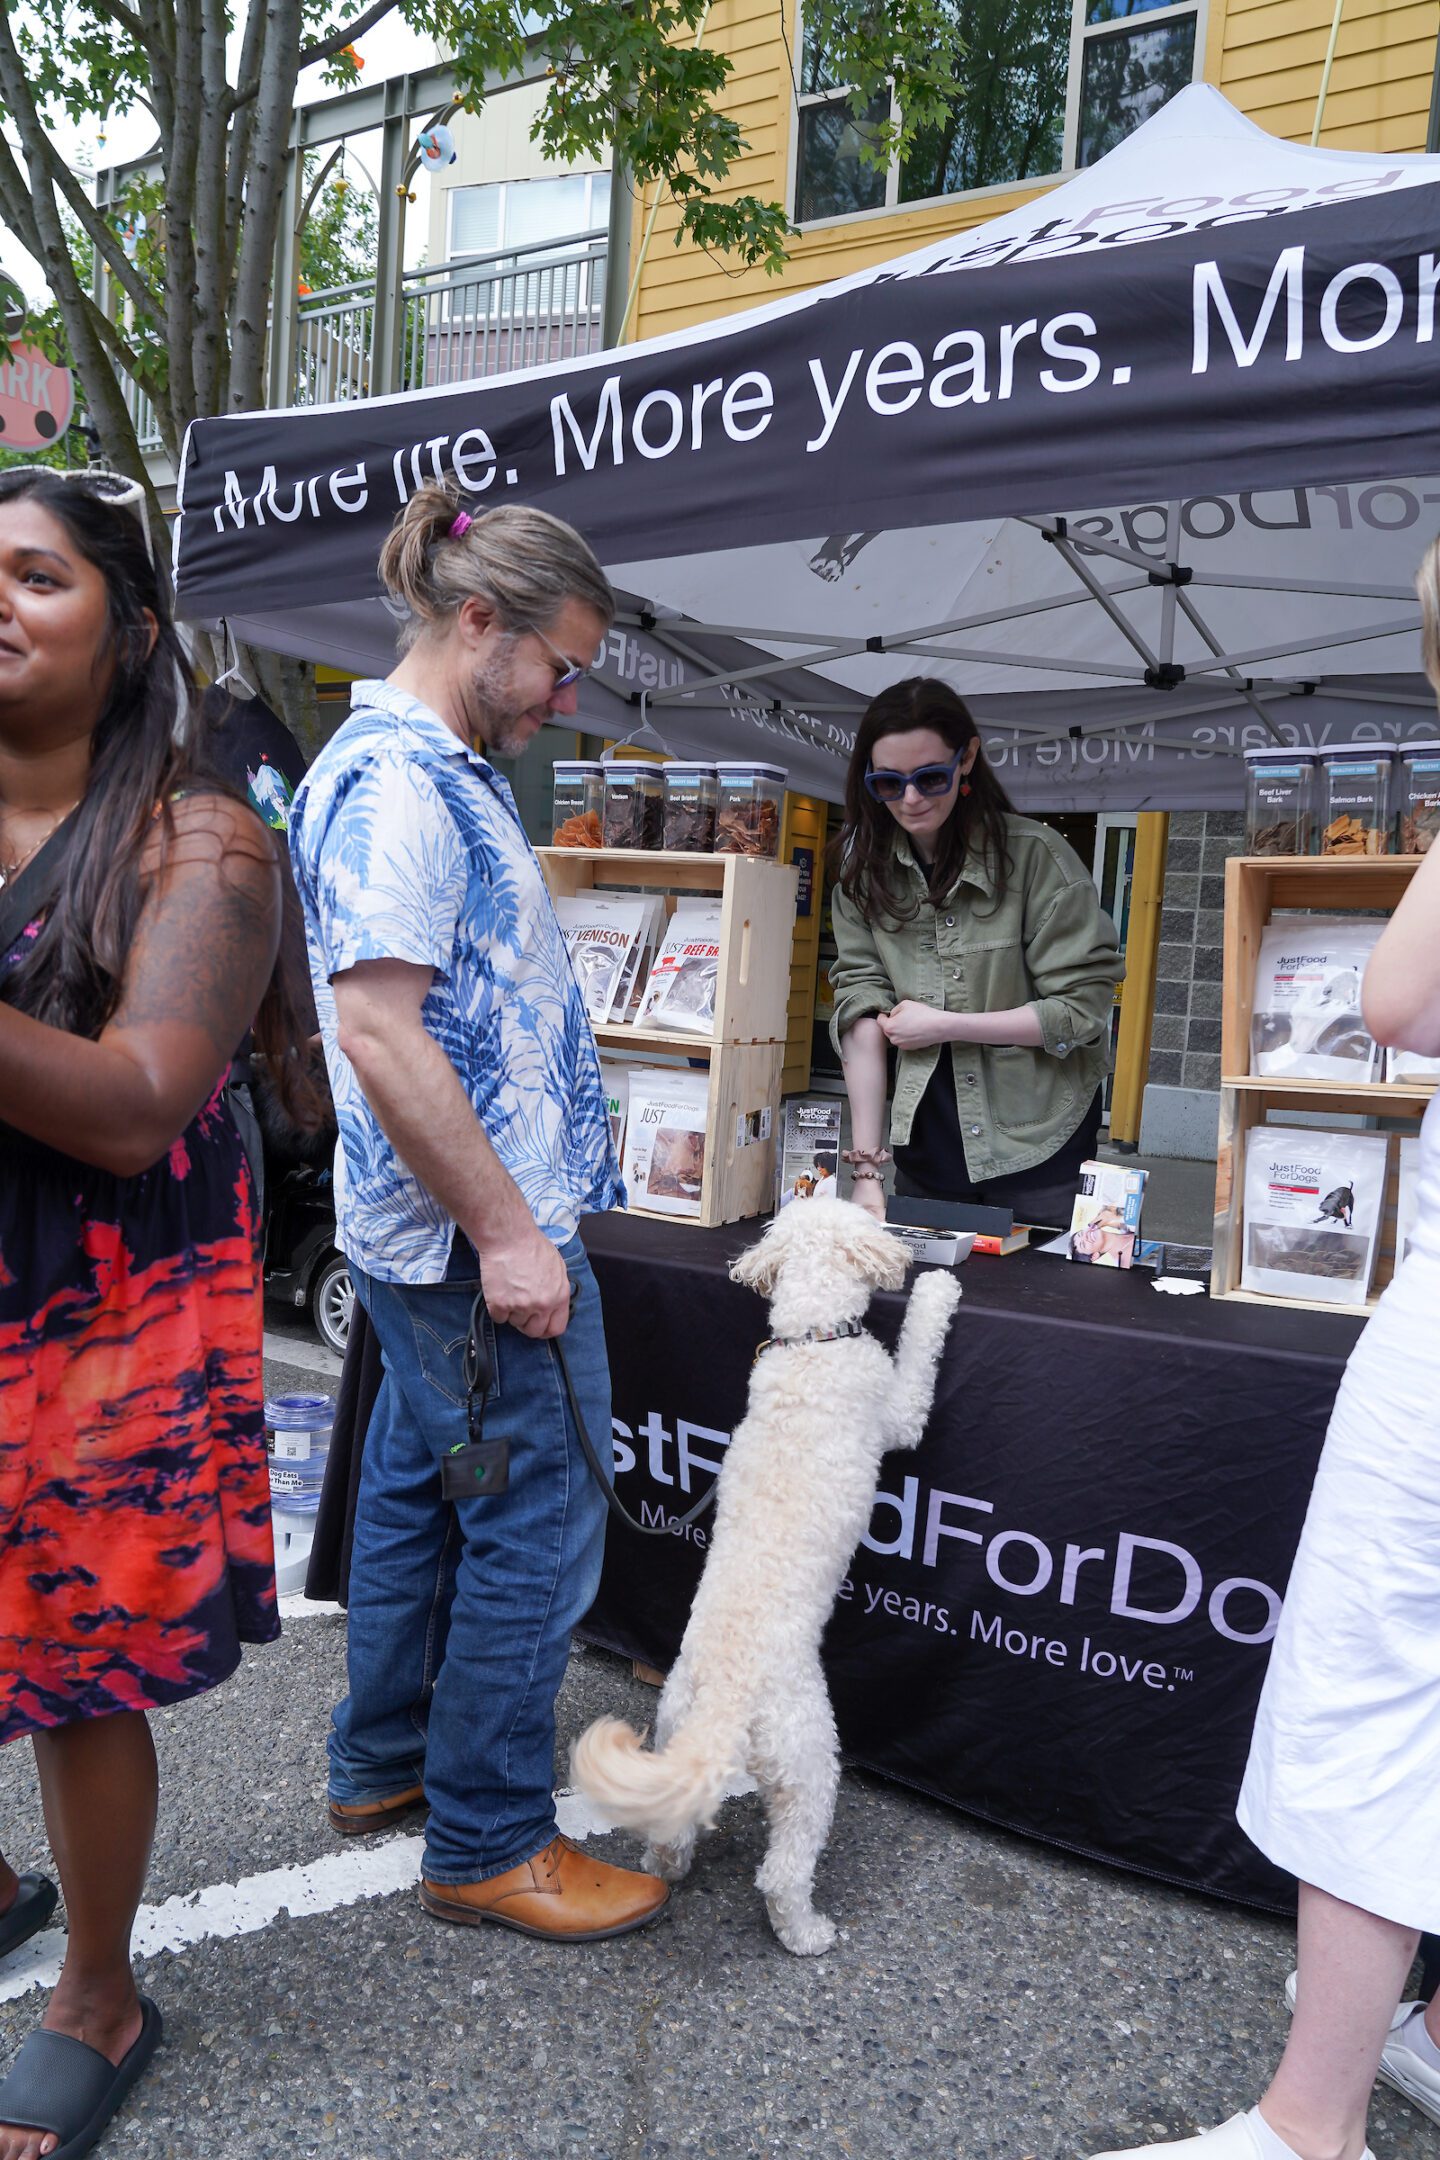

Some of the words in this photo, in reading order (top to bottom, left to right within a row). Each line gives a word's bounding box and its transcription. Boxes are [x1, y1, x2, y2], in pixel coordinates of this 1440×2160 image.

[550, 371, 774, 476] More
[806, 312, 1132, 453] years.
[1191, 245, 1440, 374] Mor
[0, 354, 53, 411] RK
[1276, 788, 1292, 796] Liver
[1408, 792, 1437, 800] Chicken
[1357, 795, 1373, 803] Bark
[577, 930, 631, 949] VENISON
[683, 944, 707, 957] BEEF
[1277, 955, 1328, 964] JustFood
[640, 1108, 667, 1124] JUST
[797, 1107, 831, 1115] JustFood
[1269, 1162, 1321, 1175] JustFood
[1273, 1171, 1318, 1184] ForDogs
[274, 1478, 290, 1486] Than
[864, 1582, 958, 1636] years.
[970, 1610, 1068, 1667] More
